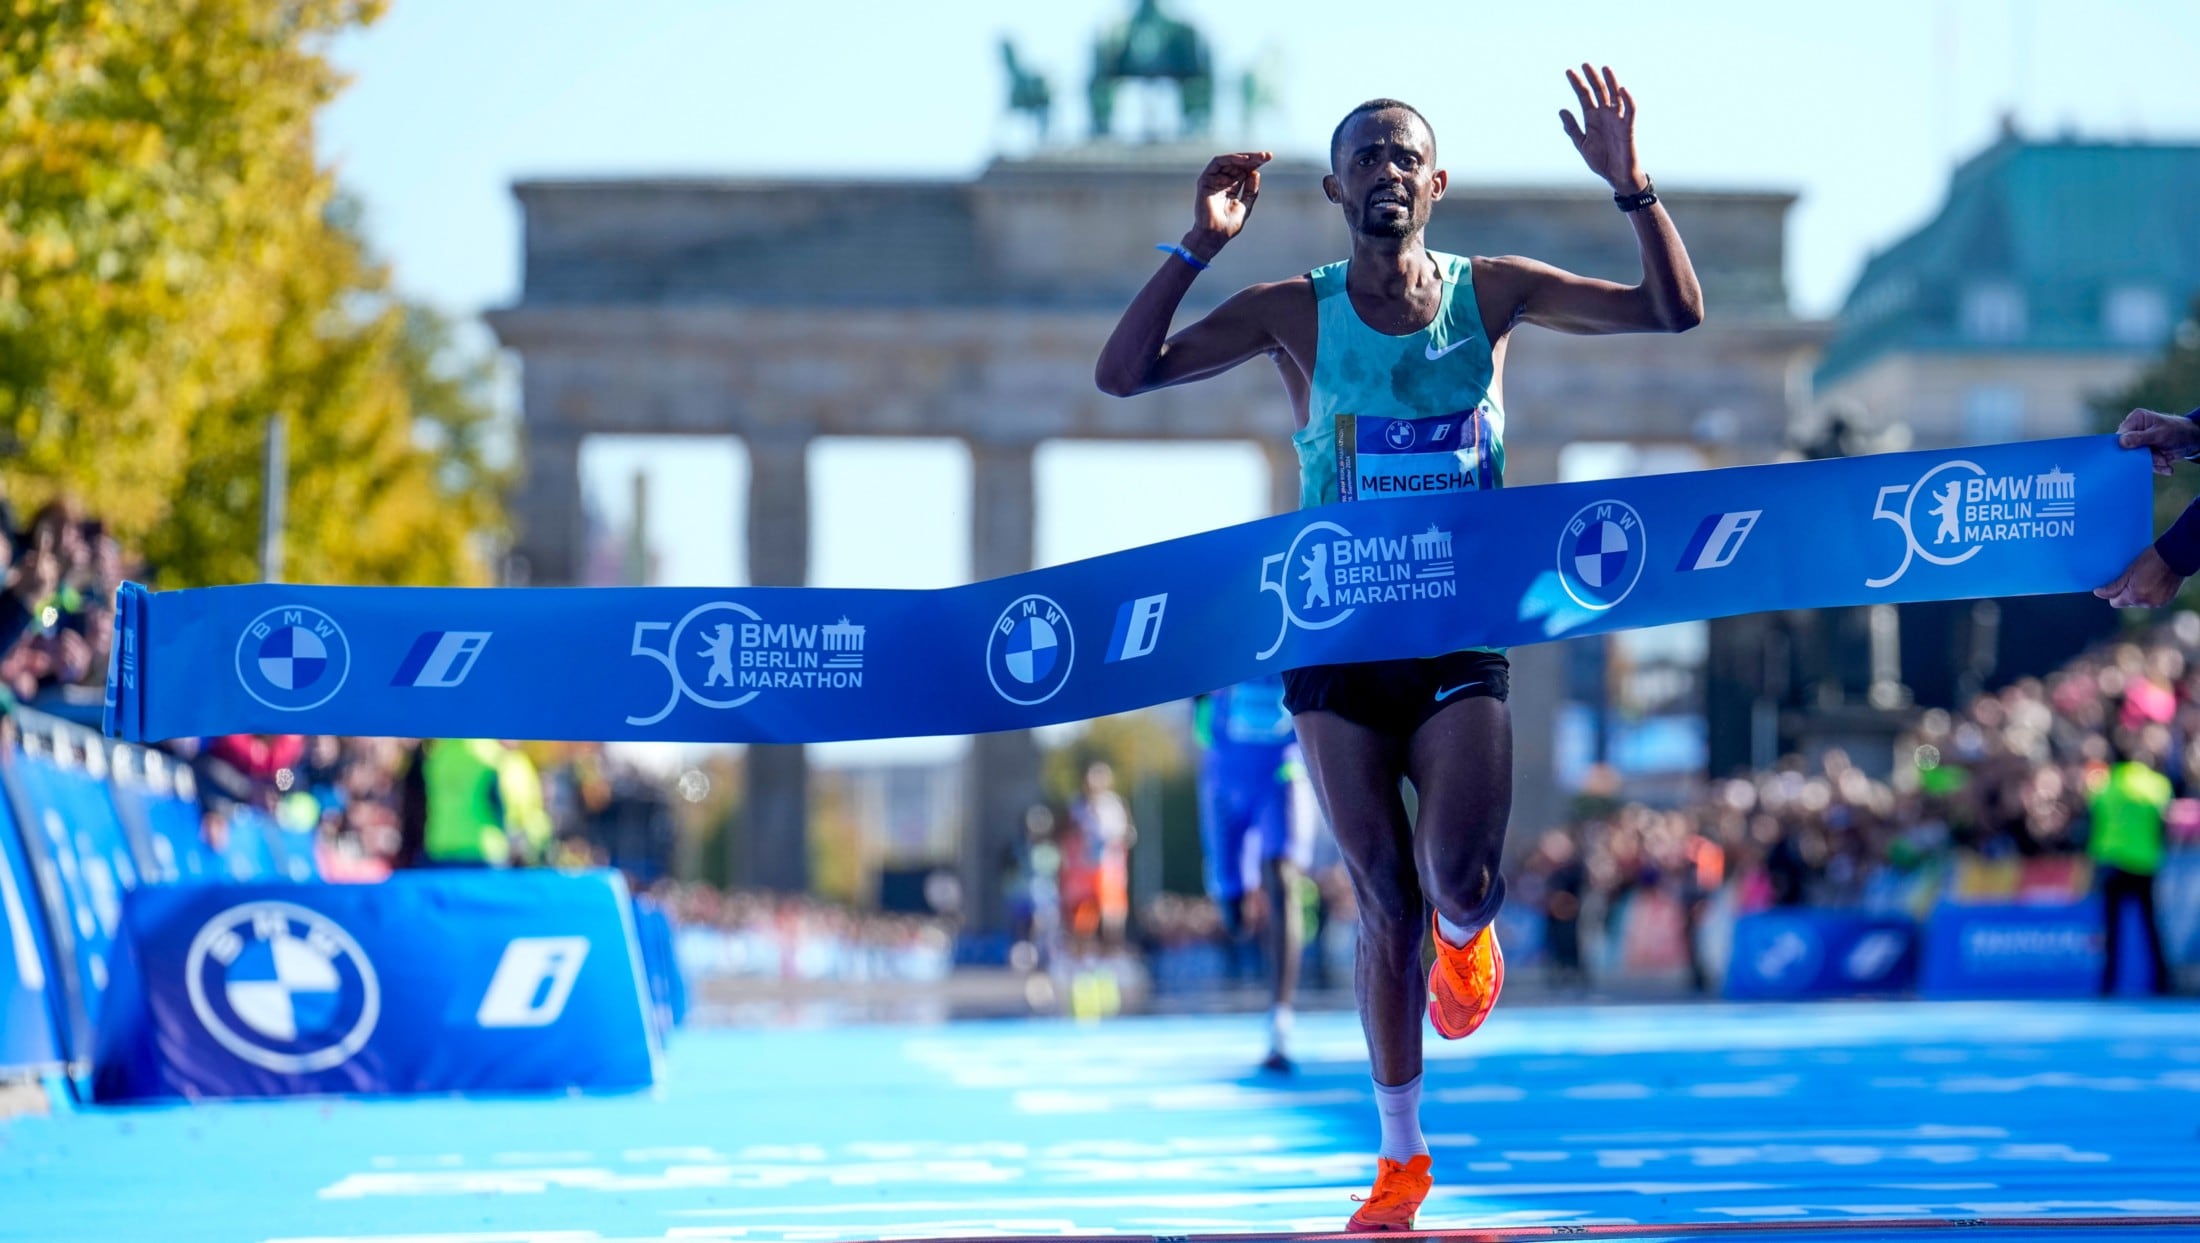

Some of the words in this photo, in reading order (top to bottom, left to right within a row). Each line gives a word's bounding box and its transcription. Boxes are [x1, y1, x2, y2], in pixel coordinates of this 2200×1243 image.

[1361, 471, 1475, 492] MENGESHA
[1966, 475, 2034, 503] BMW
[1865, 460, 1987, 588] 50
[1965, 502, 2032, 522] BERLIN
[1965, 520, 2075, 543] MARATHON
[1333, 535, 1408, 566] BMW
[1334, 563, 1411, 586] BERLIN
[1256, 521, 1356, 661] 50
[1335, 579, 1457, 606] MARATHON
[740, 623, 818, 649] BMW
[625, 601, 762, 726] 50
[740, 651, 818, 669] BERLIN
[739, 671, 862, 689] MARATHON
